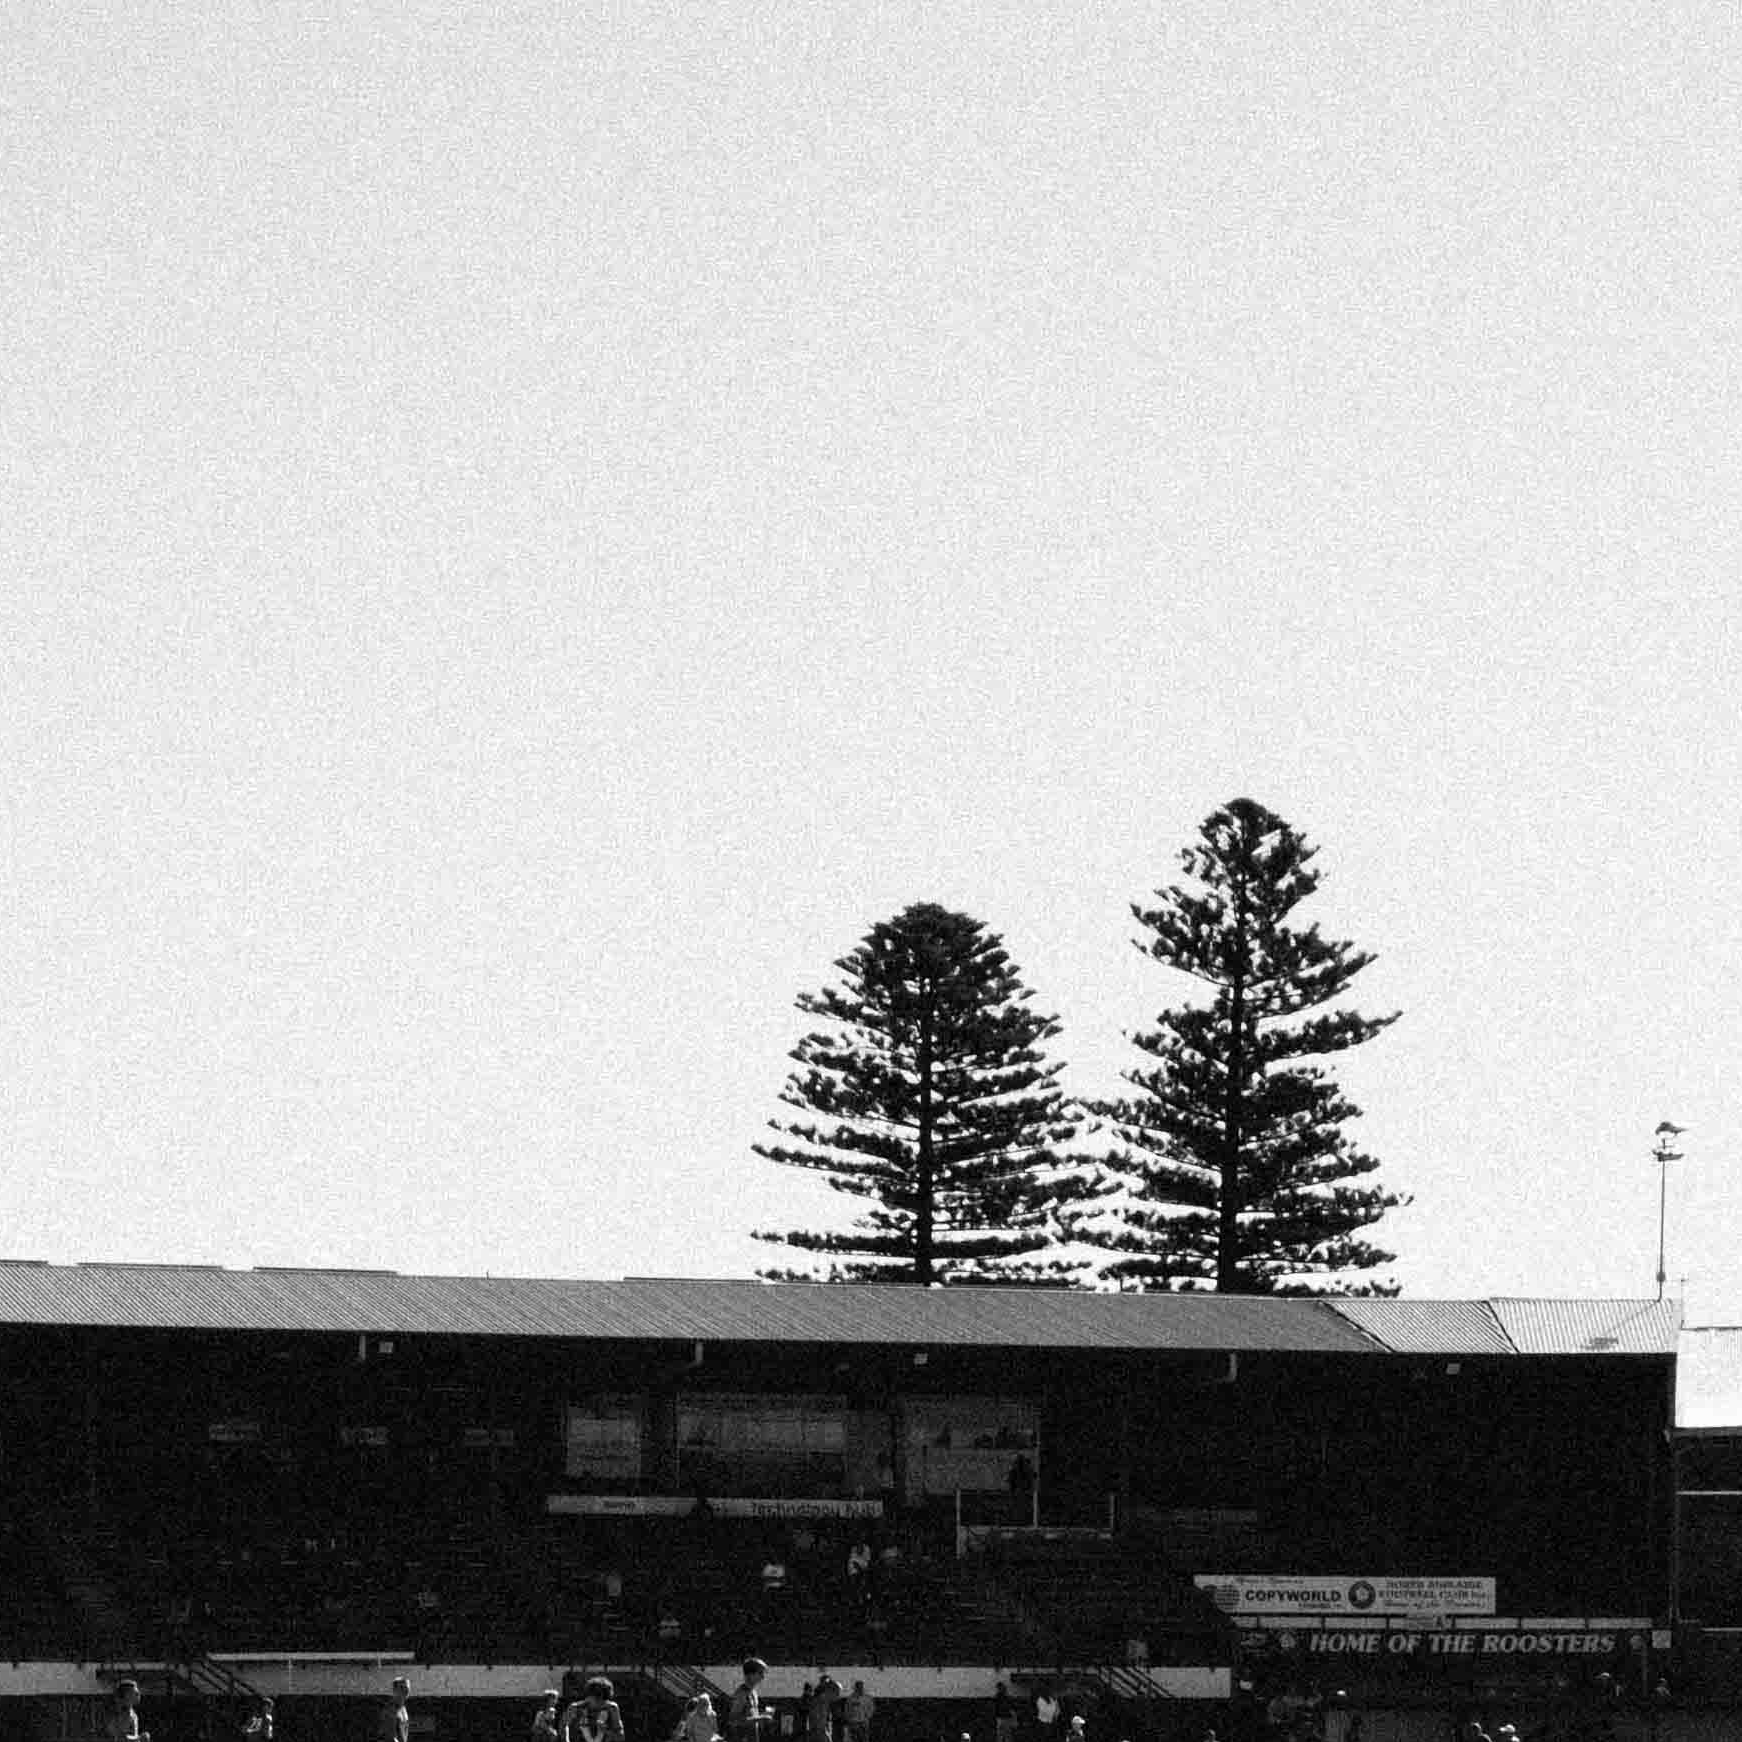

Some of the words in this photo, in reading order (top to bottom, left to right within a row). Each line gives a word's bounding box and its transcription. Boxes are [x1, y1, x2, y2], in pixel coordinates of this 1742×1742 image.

[1245, 1589, 1342, 1601] COPYWORLD
[1309, 1633, 1380, 1652] HOME
[1388, 1633, 1421, 1653] OF
[1428, 1633, 1476, 1653] THE
[1482, 1633, 1618, 1653] ROOSTERS
